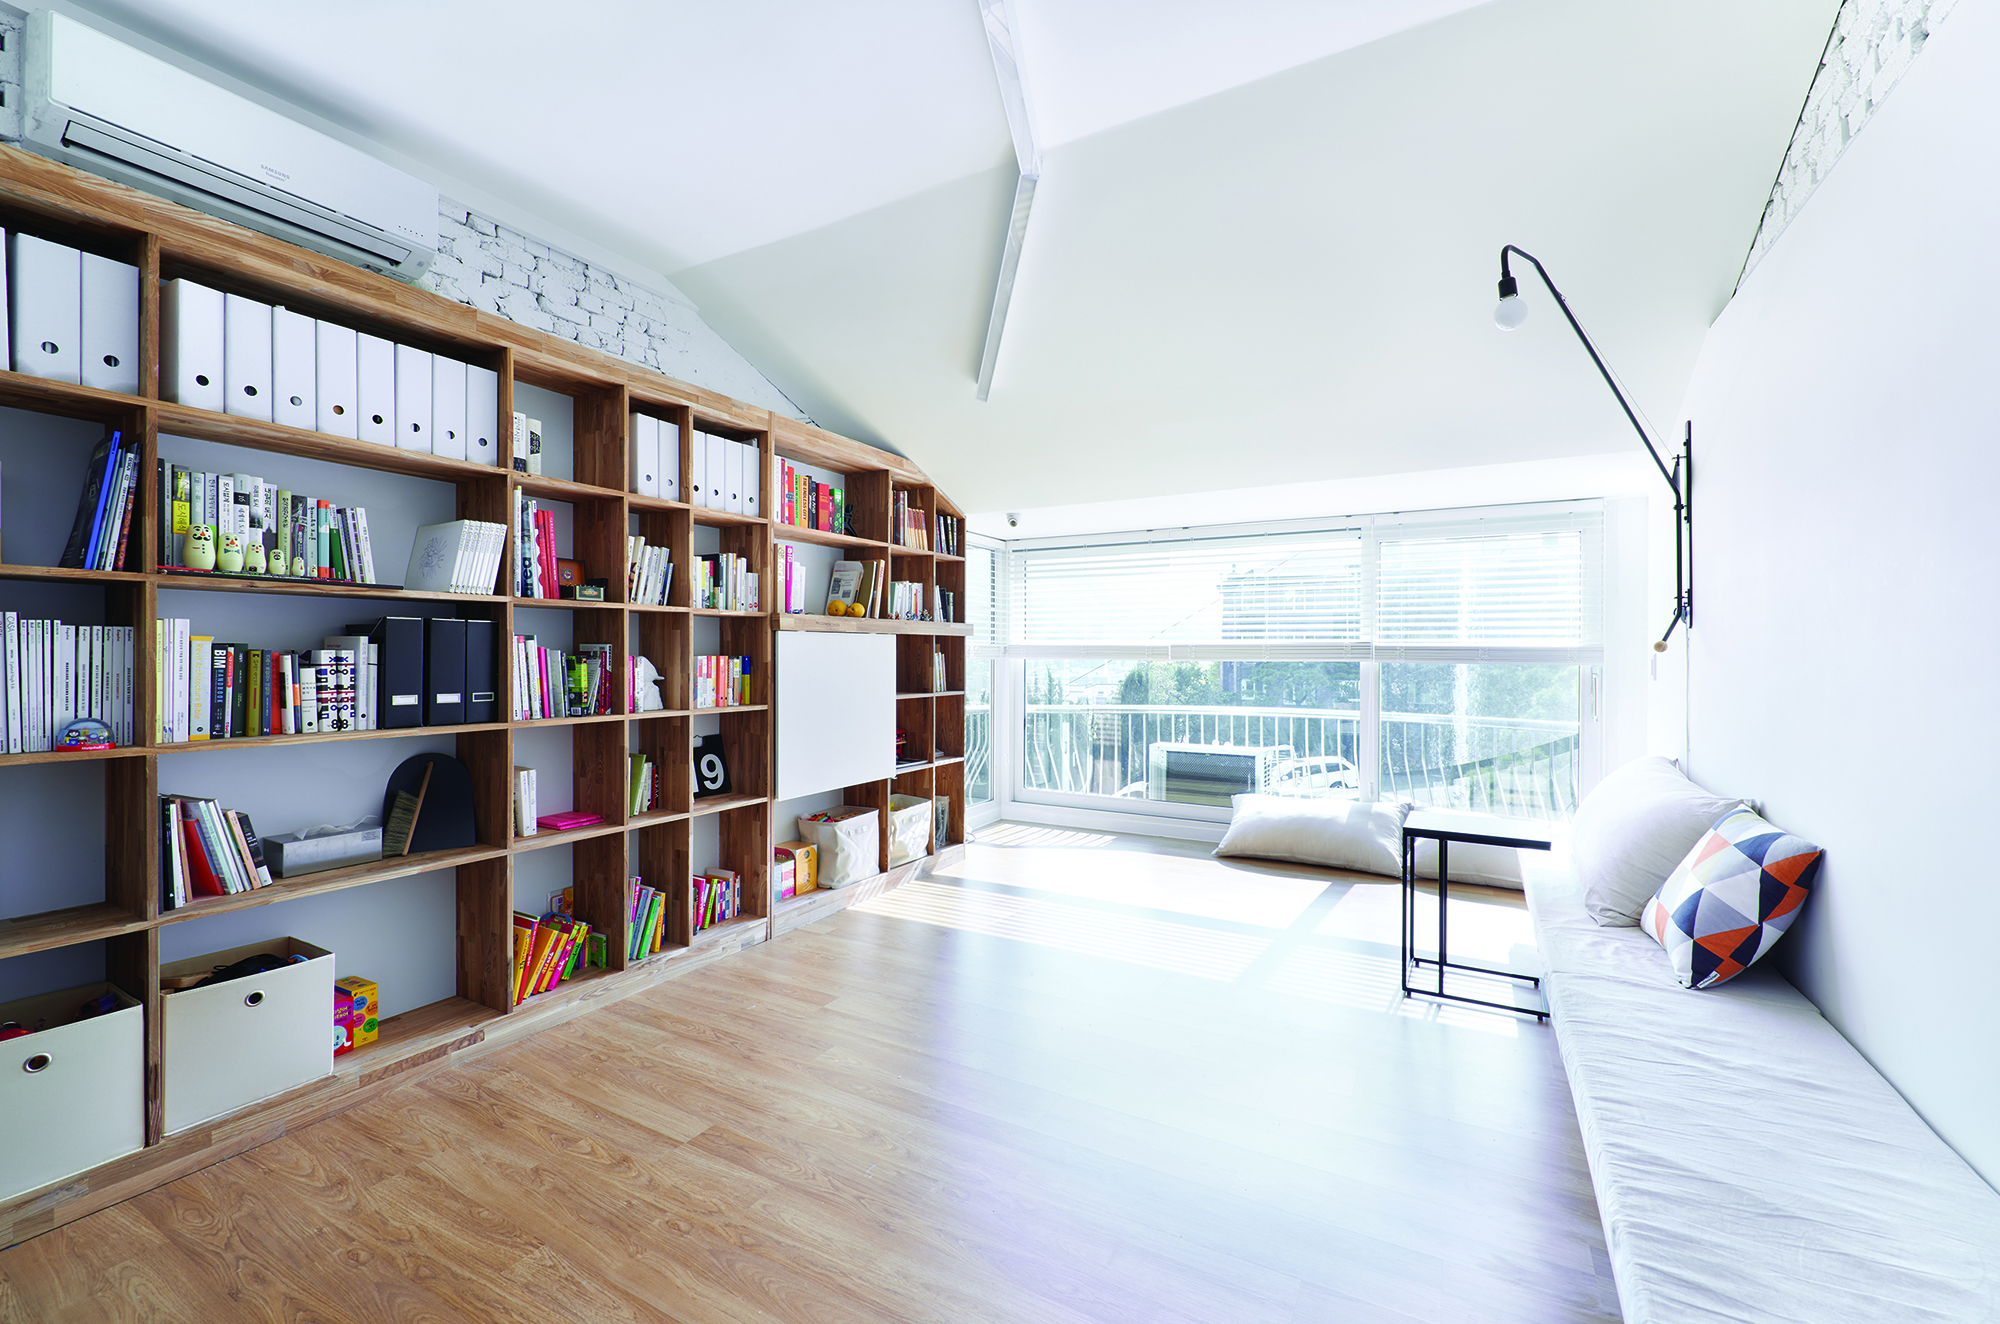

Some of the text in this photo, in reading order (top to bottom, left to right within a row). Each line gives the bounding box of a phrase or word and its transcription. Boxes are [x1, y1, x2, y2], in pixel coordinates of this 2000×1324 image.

[260, 164, 290, 180] SAMSUNG
[176, 503, 187, 532] 도시해석
[523, 557, 534, 598] area
[6, 616, 15, 633] CASA
[214, 650, 226, 668] BIM
[194, 643, 204, 720] Revit Architecture Bible
[700, 753, 724, 790] 9
